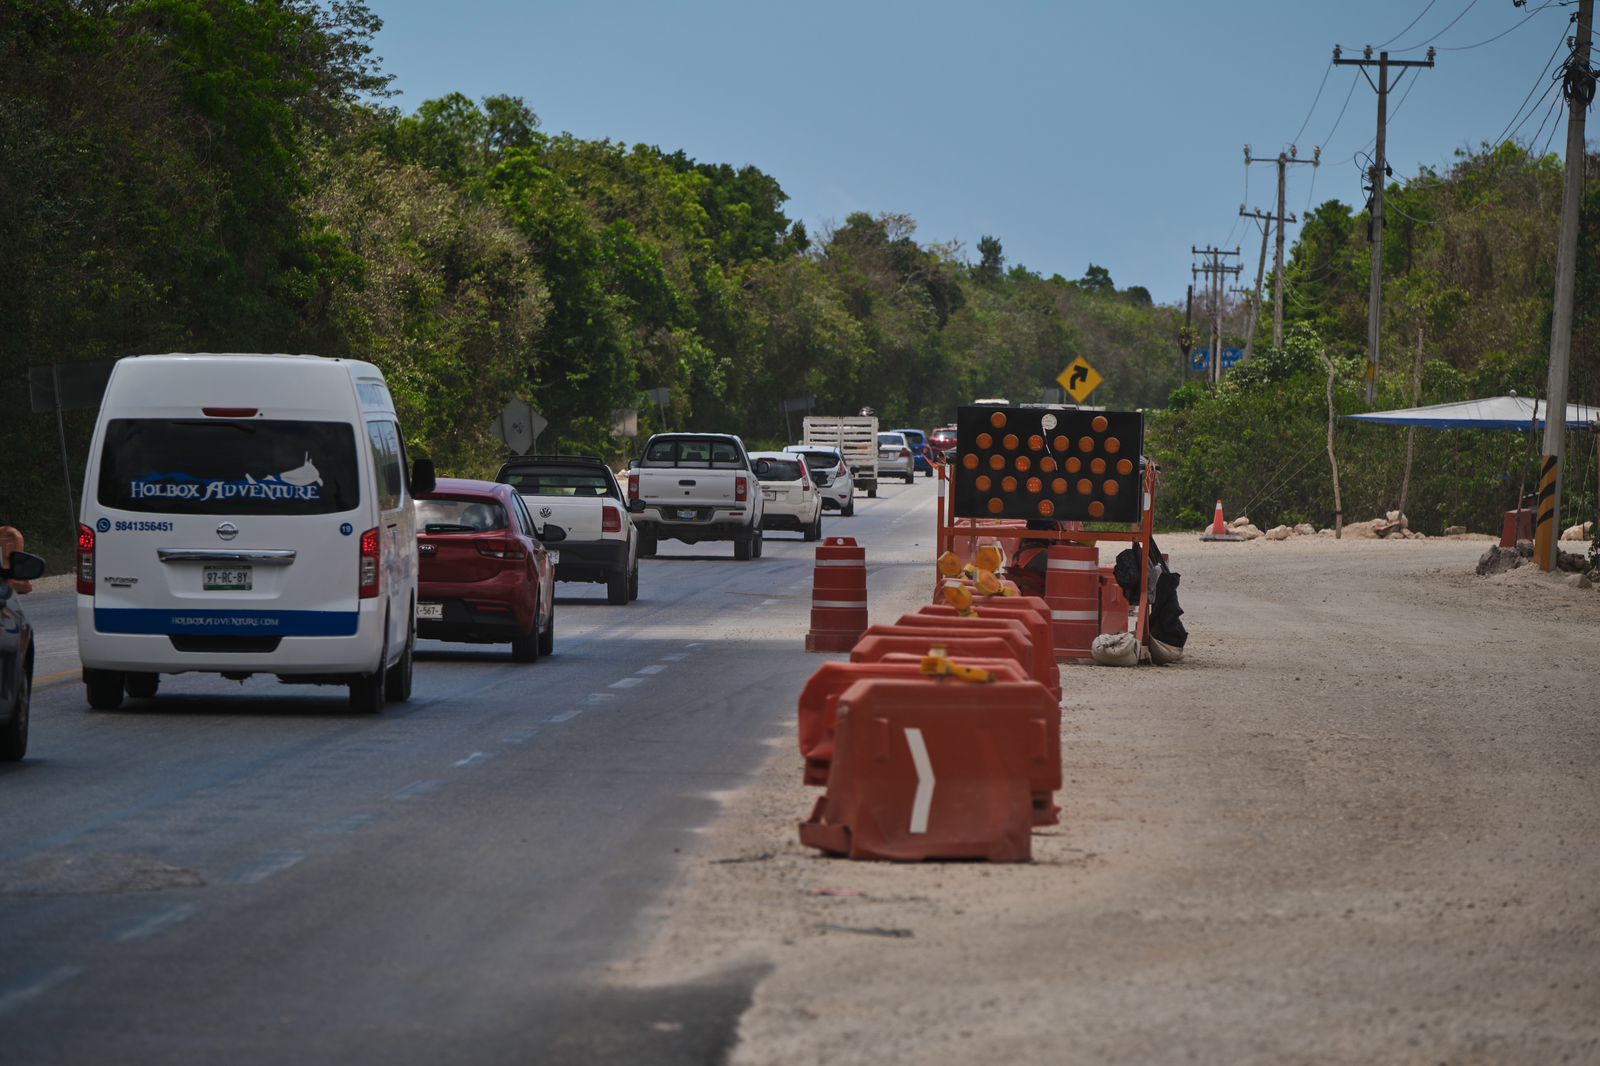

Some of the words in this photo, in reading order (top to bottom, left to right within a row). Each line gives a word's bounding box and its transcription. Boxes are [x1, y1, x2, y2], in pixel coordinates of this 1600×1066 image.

[130, 481, 200, 499] HOLBOX
[200, 481, 320, 502] ADVENTURE
[115, 521, 173, 532] 9841356451
[207, 572, 248, 583] 97-RC-8Y
